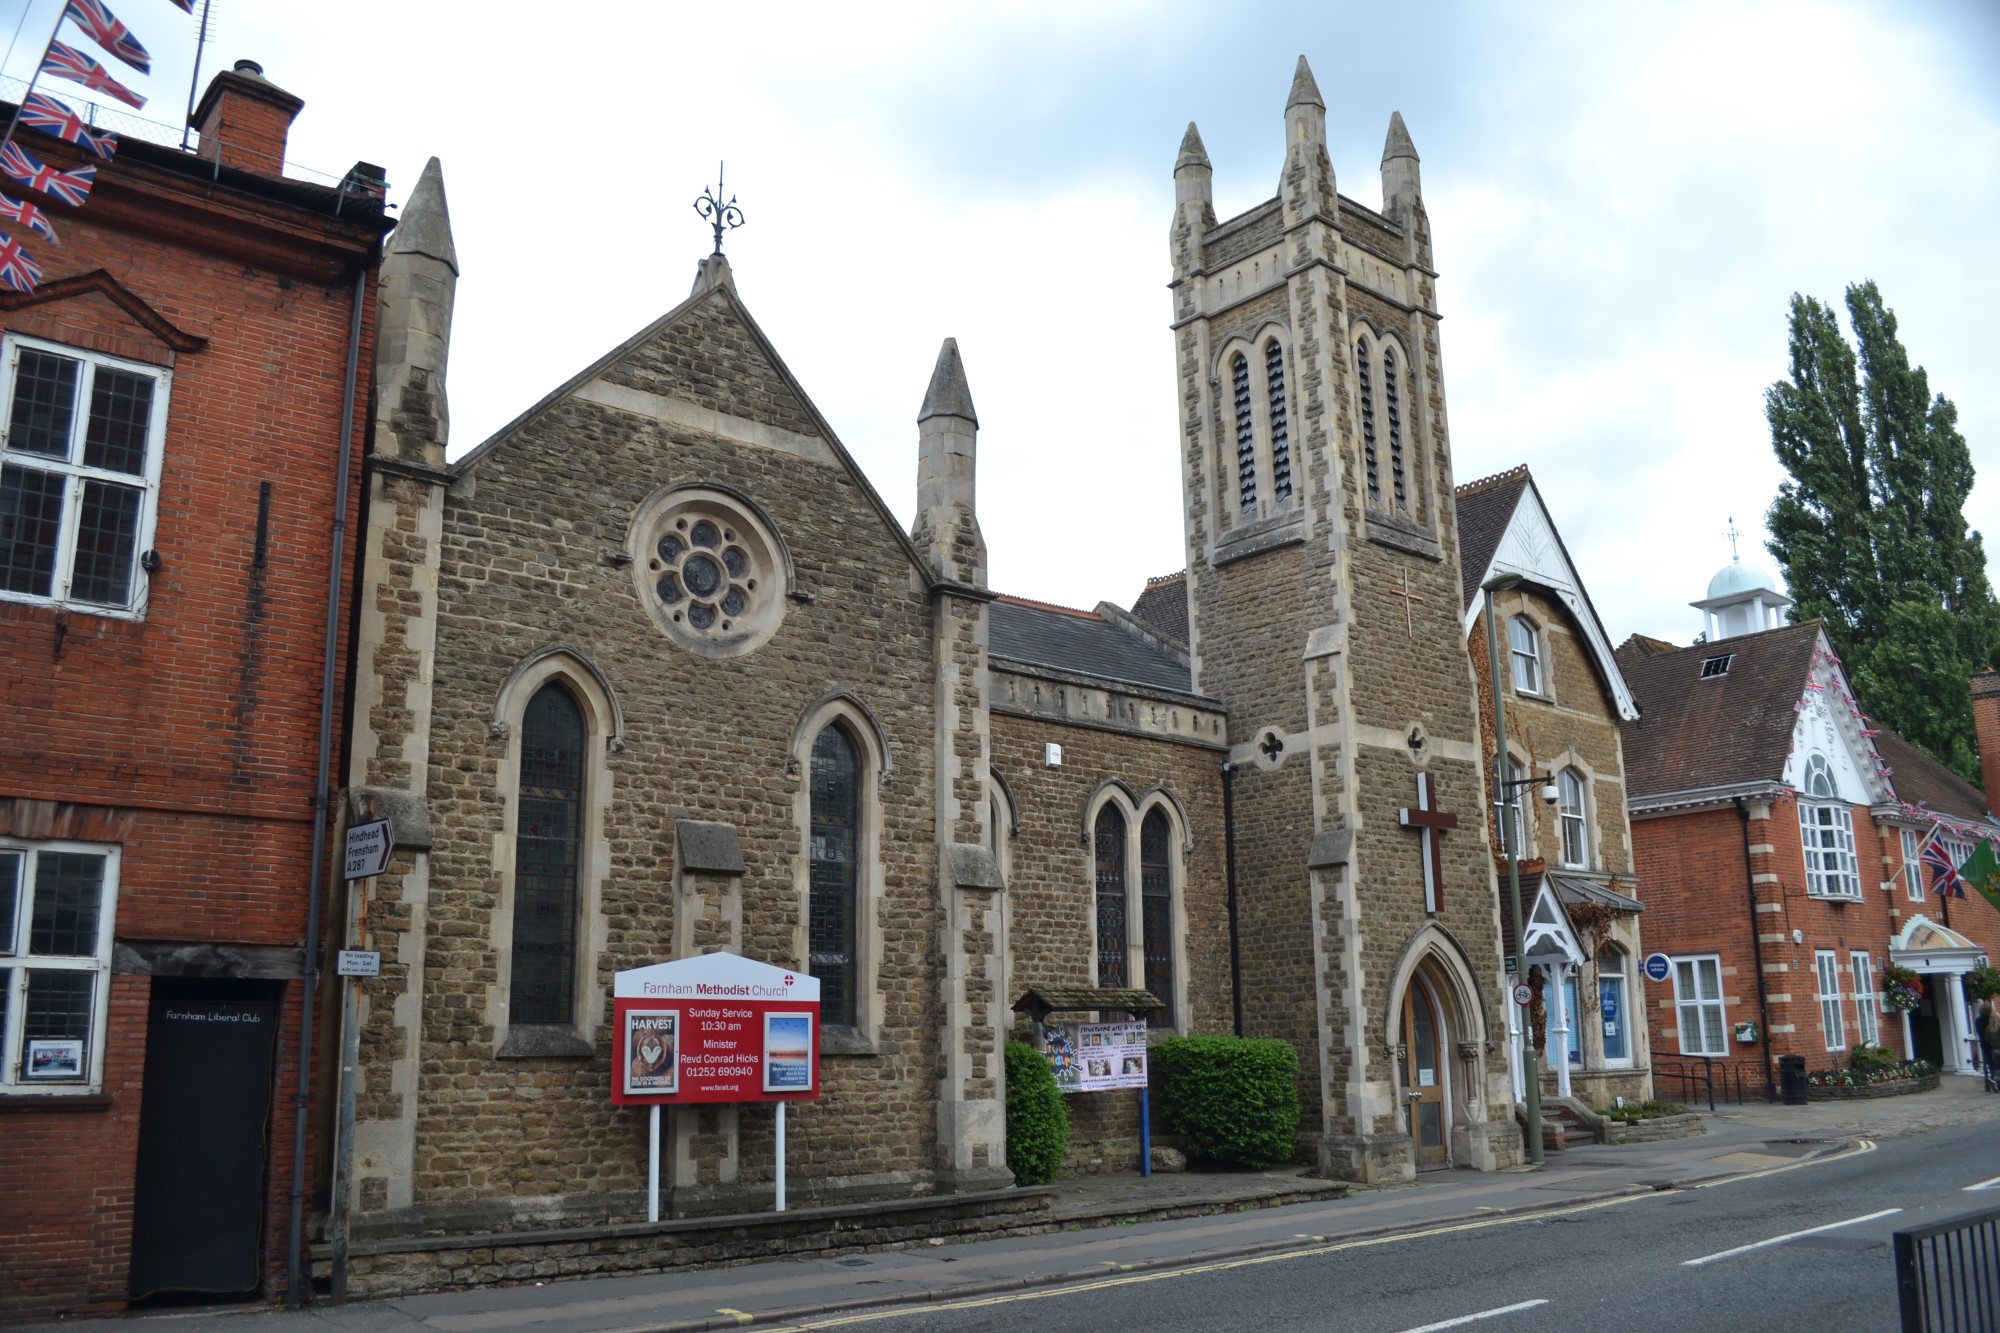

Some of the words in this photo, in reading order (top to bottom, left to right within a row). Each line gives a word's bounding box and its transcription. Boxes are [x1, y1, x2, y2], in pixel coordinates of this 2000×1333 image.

[349, 827, 380, 845] Hindhead
[348, 844, 379, 858] Frensham
[346, 859, 365, 872] A287
[643, 982, 693, 995] Farnham
[696, 984, 750, 996] Methodist
[752, 984, 788, 996] Church
[166, 1010, 206, 1020] Farnham
[208, 1012, 240, 1022] Liberal
[242, 1013, 261, 1023] Club
[689, 1007, 720, 1019] Sunday
[722, 1008, 753, 1018] Service
[631, 1019, 673, 1029] HARVEST
[700, 1021, 726, 1031] 10:30
[728, 1023, 742, 1031] am
[703, 1040, 738, 1049] Minister
[680, 1054, 702, 1064] Revd
[703, 1054, 734, 1063] Conrad
[736, 1054, 759, 1063] Hicks
[686, 1067, 716, 1077] 01252
[717, 1066, 753, 1076] 690940
